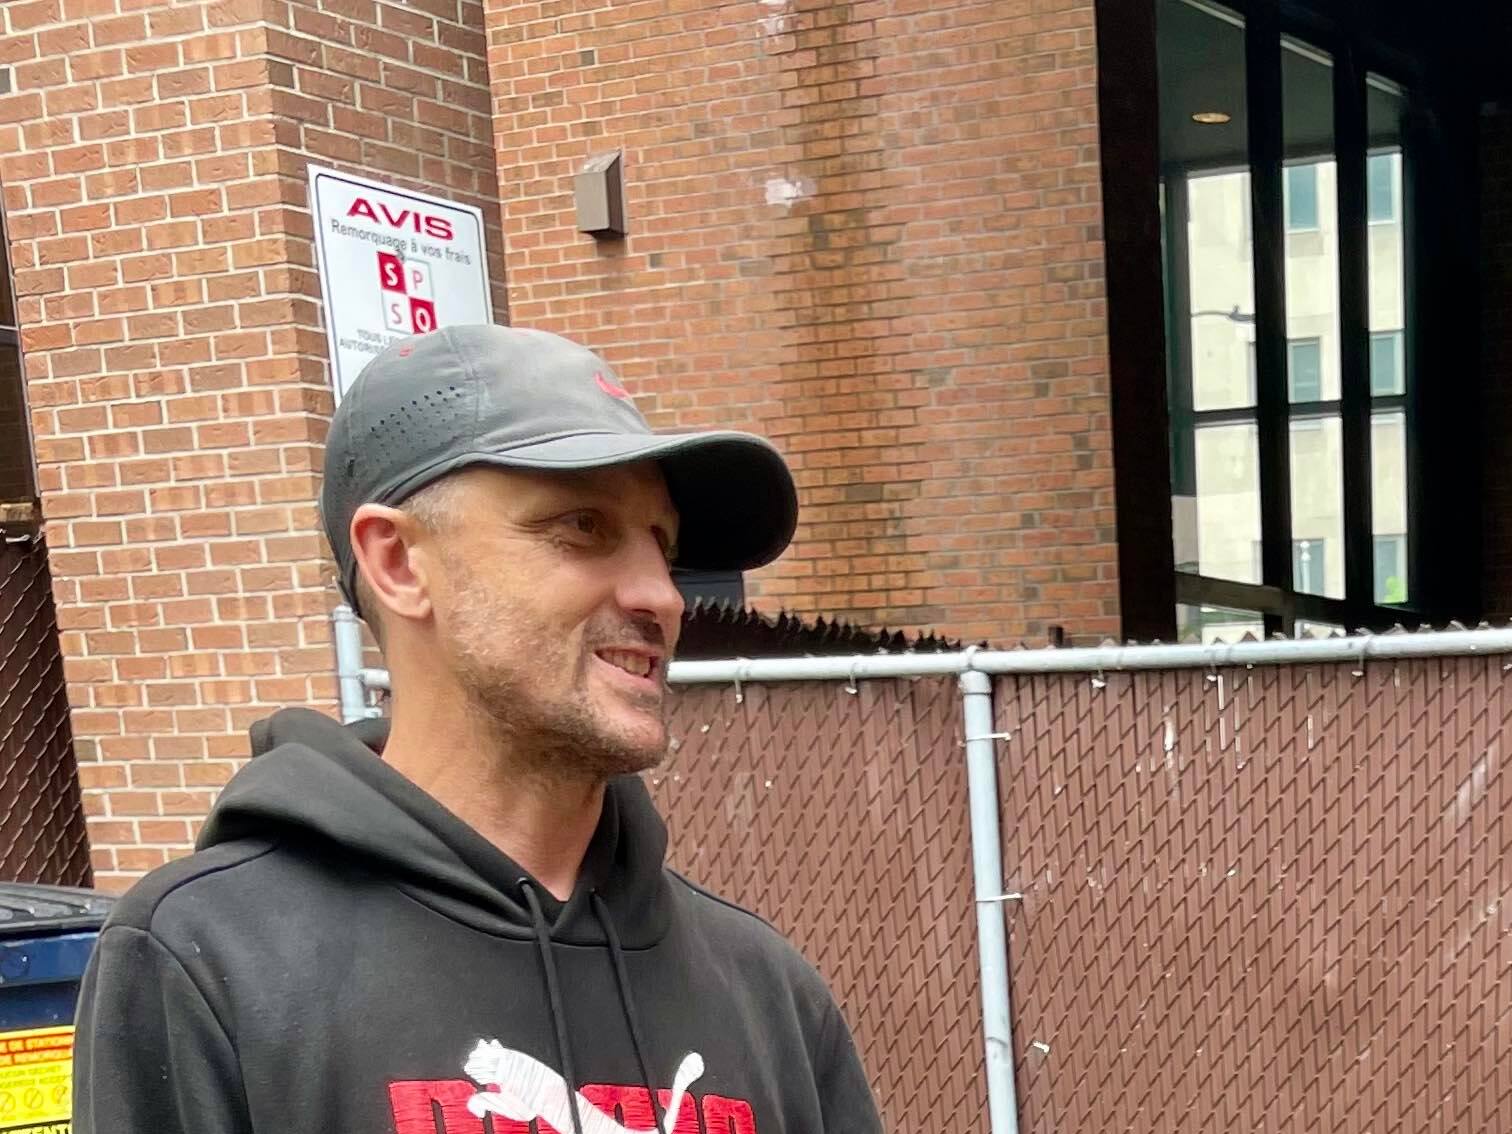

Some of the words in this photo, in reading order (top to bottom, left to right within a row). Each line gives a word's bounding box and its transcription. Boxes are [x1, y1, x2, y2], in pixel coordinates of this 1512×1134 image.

[331, 219, 407, 252] Remorquage
[421, 244, 443, 259] vos
[347, 198, 454, 241] AVIS
